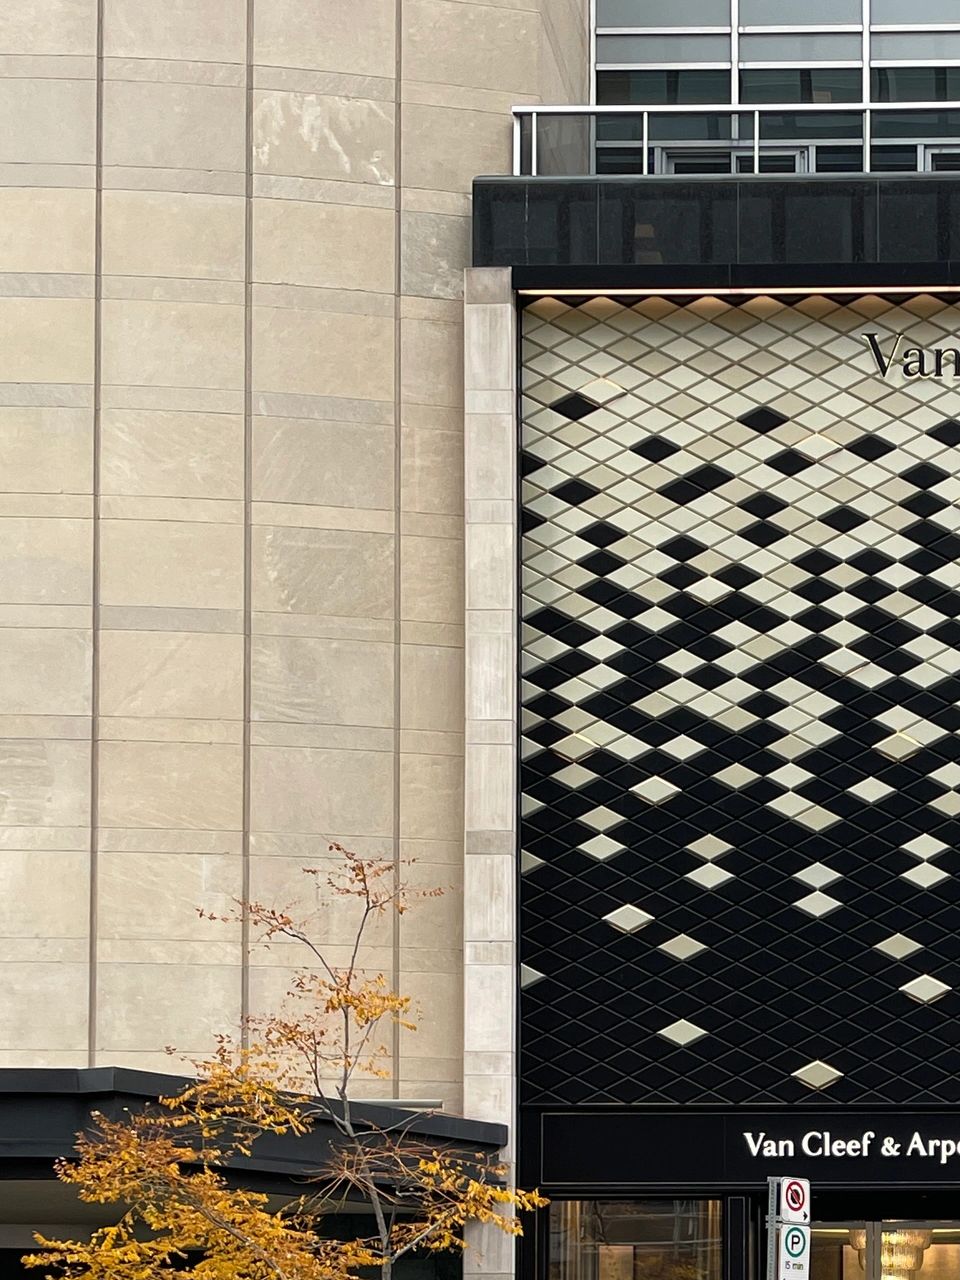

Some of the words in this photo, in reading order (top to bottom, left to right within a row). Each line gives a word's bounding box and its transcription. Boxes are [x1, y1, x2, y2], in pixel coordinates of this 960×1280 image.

[743, 1132, 795, 1157] Van
[801, 1131, 875, 1157] Cleef
[880, 1136, 901, 1157] &
[791, 1234, 801, 1251] P
